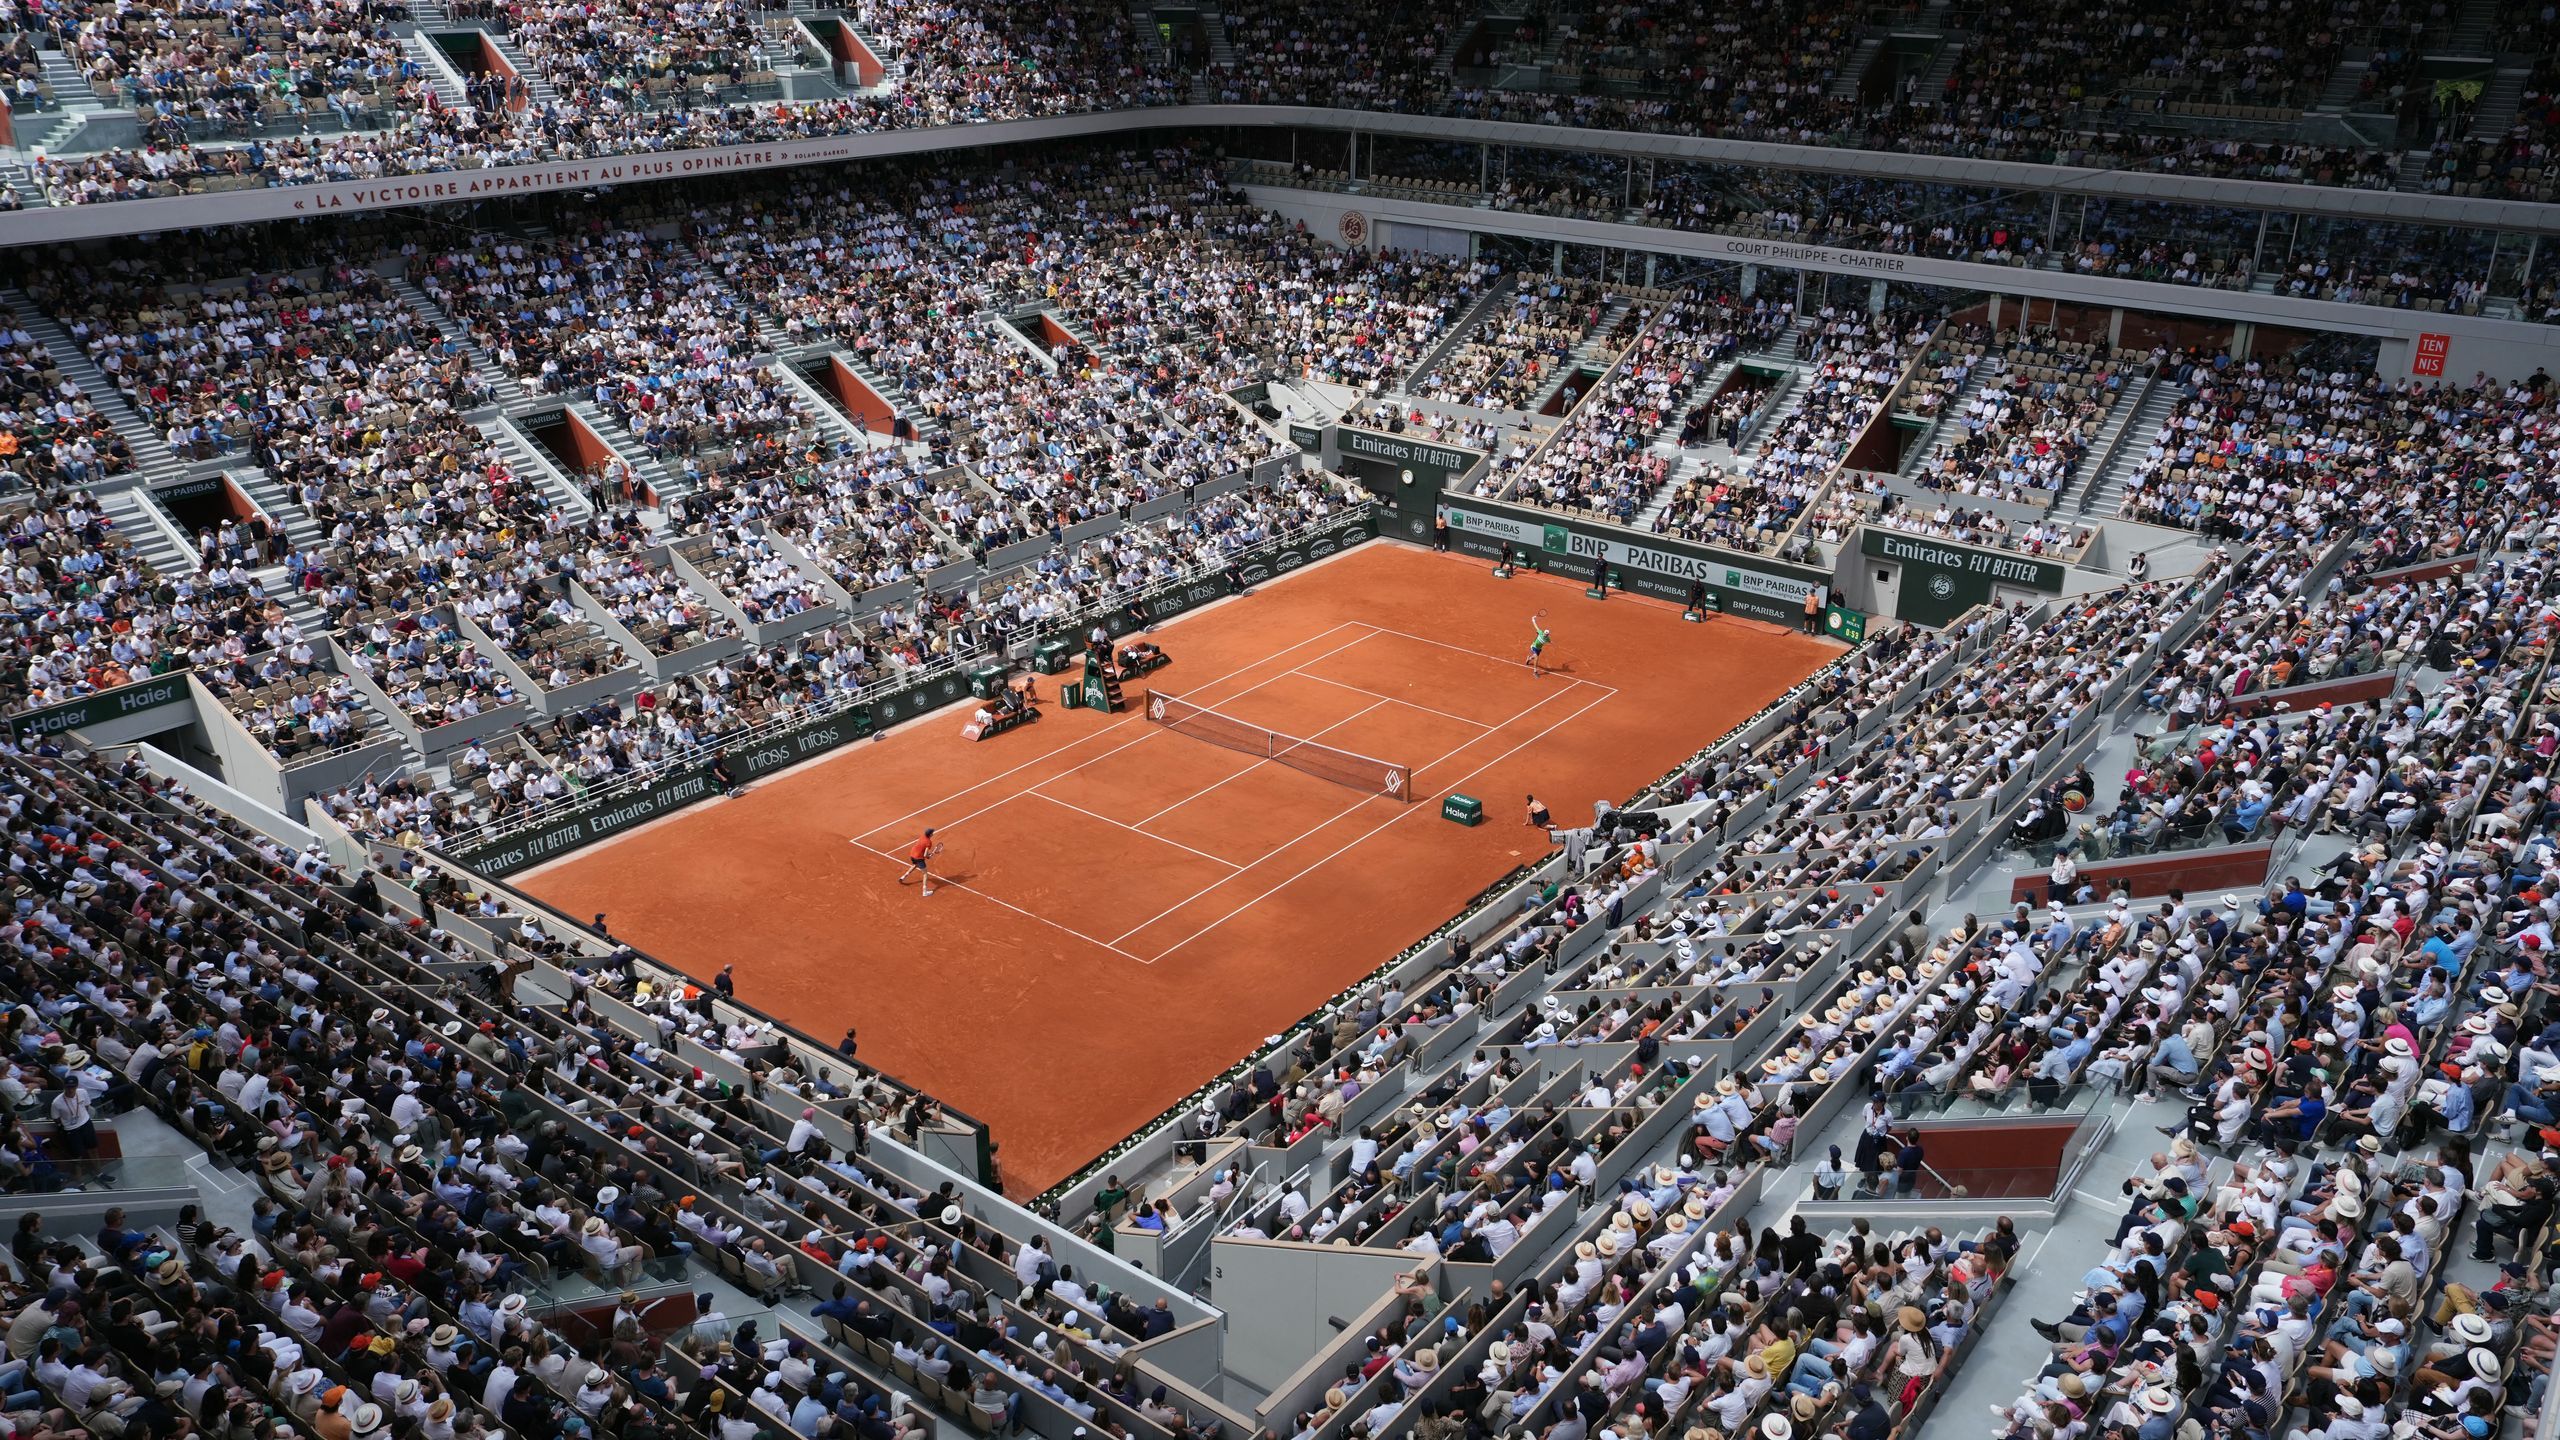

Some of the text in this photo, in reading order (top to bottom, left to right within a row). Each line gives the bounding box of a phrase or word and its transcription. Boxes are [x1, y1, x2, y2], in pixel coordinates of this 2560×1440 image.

[316, 194, 342, 208] LA
[353, 183, 457, 204] VICTOIRE
[469, 169, 590, 192] APPARTIENT
[601, 167, 622, 179] AU
[633, 161, 674, 176] PLUS
[683, 151, 773, 171] OPINIÂTRE
[795, 152, 821, 160] ROLAND
[823, 149, 849, 157] GARROS
[1727, 241, 1769, 256] COURT
[1772, 246, 1828, 262] PHILIPPE
[1839, 254, 1904, 271] CHATRIER
[2423, 339, 2444, 352] TEN
[801, 359, 827, 369] PARIBAS
[2418, 358, 2440, 371] NIS
[528, 413, 562, 425] PARIBAS
[1353, 434, 1461, 469] Emirates FLY BETTER
[150, 481, 216, 500] BNP PARIBAS
[1466, 516, 1520, 535] BNP PARIBAS
[1463, 541, 1503, 555] BNP PARIBA
[1571, 535, 1706, 580] BNP PARIBAS
[1548, 560, 1595, 577] BNP PARIBAS
[1883, 537, 2038, 583] Emirates FLY BETTER
[1188, 583, 1215, 602] Infosys
[1637, 580, 1687, 597] BNP PARIBAS
[1743, 575, 1807, 597] BNP PARIBAS
[1155, 595, 1183, 615] Infosys
[1733, 601, 1785, 619] BNP PARIBAS
[1846, 620, 1860, 628] ROLEX
[1845, 629, 1859, 639] 0:53
[120, 686, 172, 711] Haier
[31, 709, 86, 734] Haier
[797, 726, 839, 751] Infosys
[746, 744, 790, 771] Infosys
[589, 777, 705, 833] Emirates FLY BETTER
[1446, 806, 1467, 819] Haier
[474, 824, 581, 874] mirates FLY BETTER
[1216, 1266, 1222, 1278] 3
